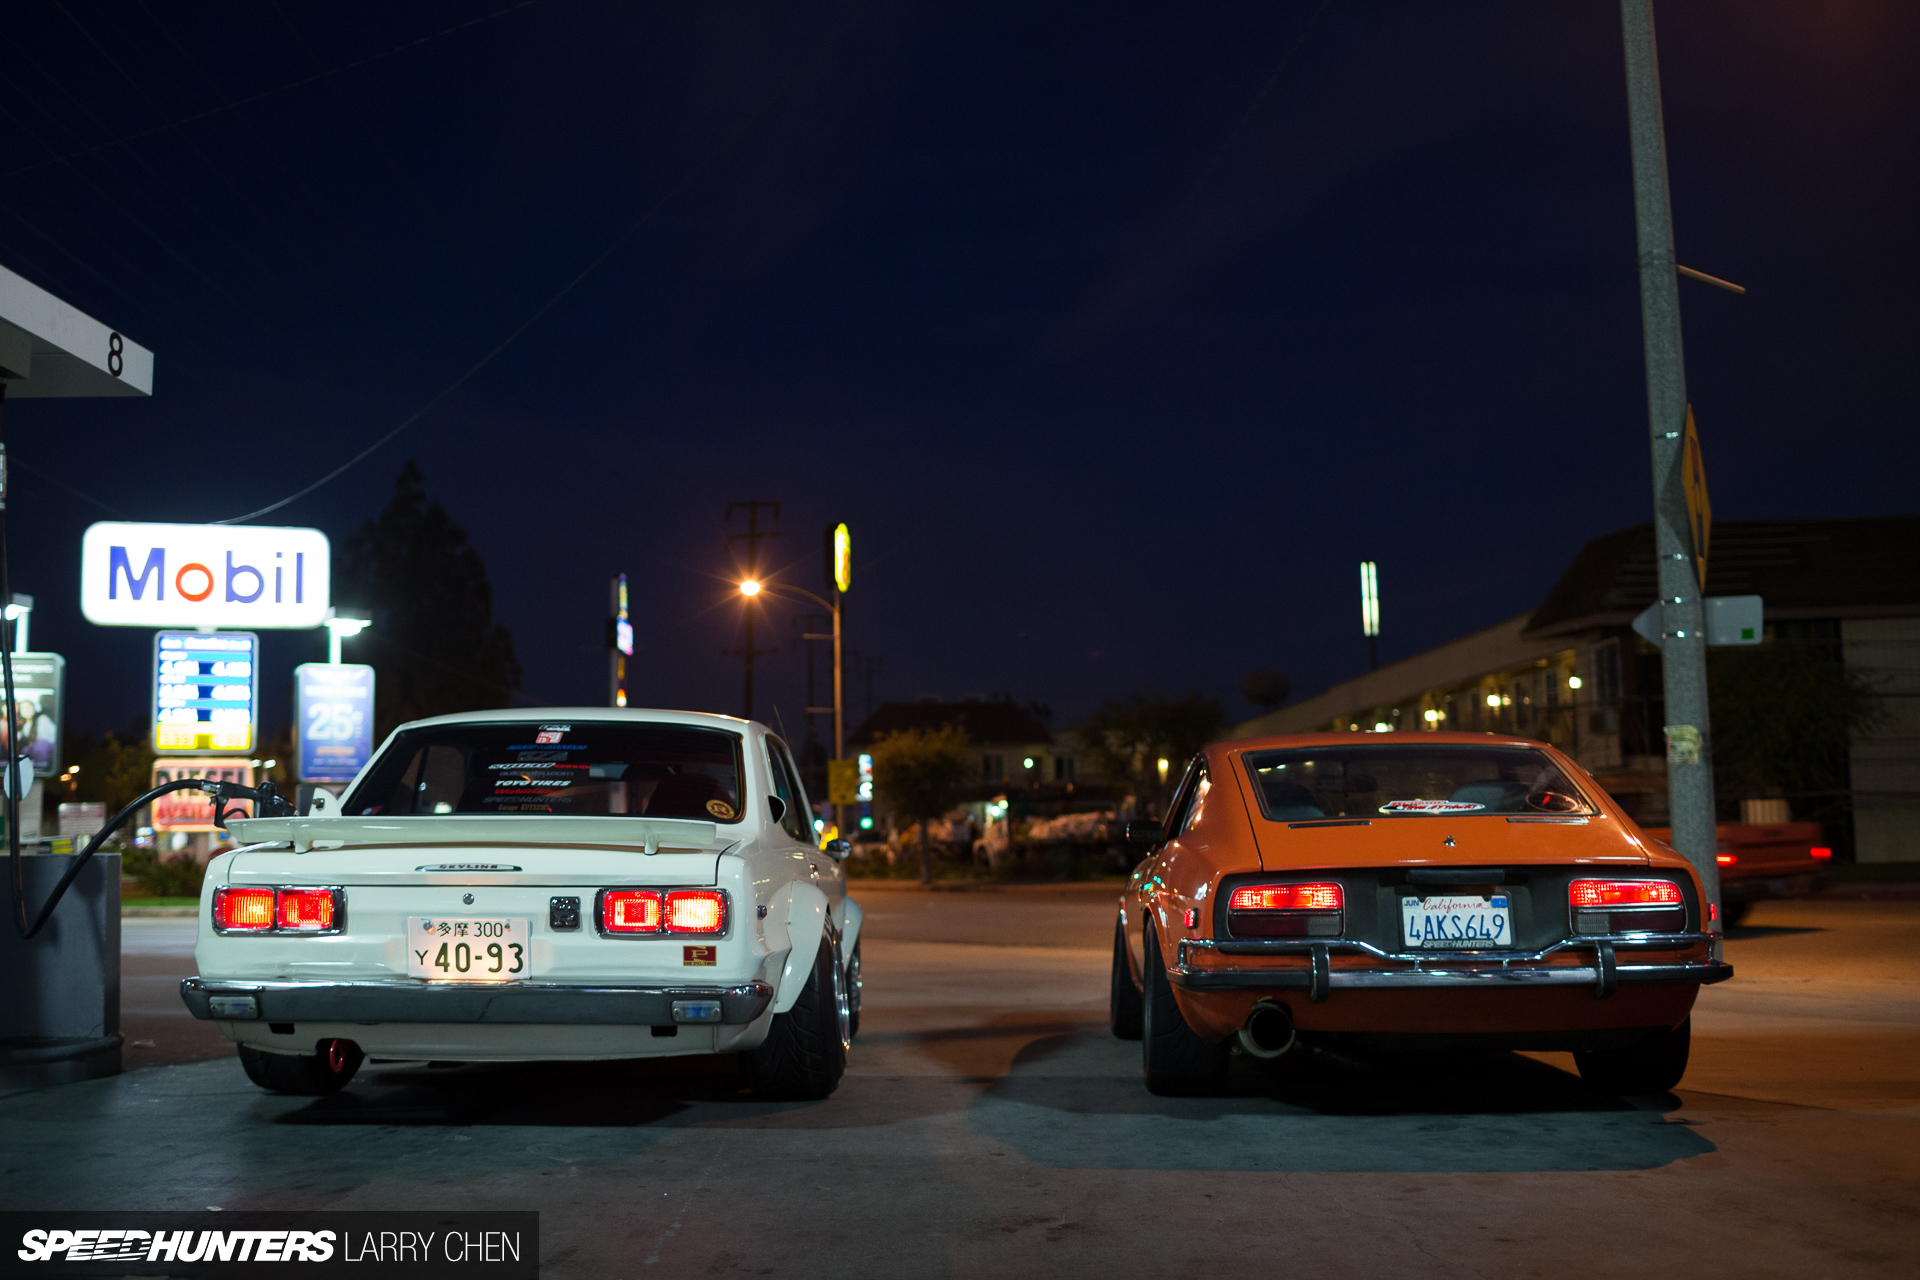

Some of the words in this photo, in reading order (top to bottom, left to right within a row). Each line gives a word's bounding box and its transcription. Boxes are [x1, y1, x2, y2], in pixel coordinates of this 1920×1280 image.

[107, 332, 124, 377] 8
[108, 545, 305, 604] Mobil
[1403, 899, 1420, 907] JUN
[1422, 897, 1490, 914] California
[436, 922, 470, 938] 多摩
[473, 922, 504, 938] 300
[1409, 913, 1505, 940] 4AKS649
[1422, 939, 1495, 948] SPEEDHUNTERS
[434, 942, 525, 974] 40-93
